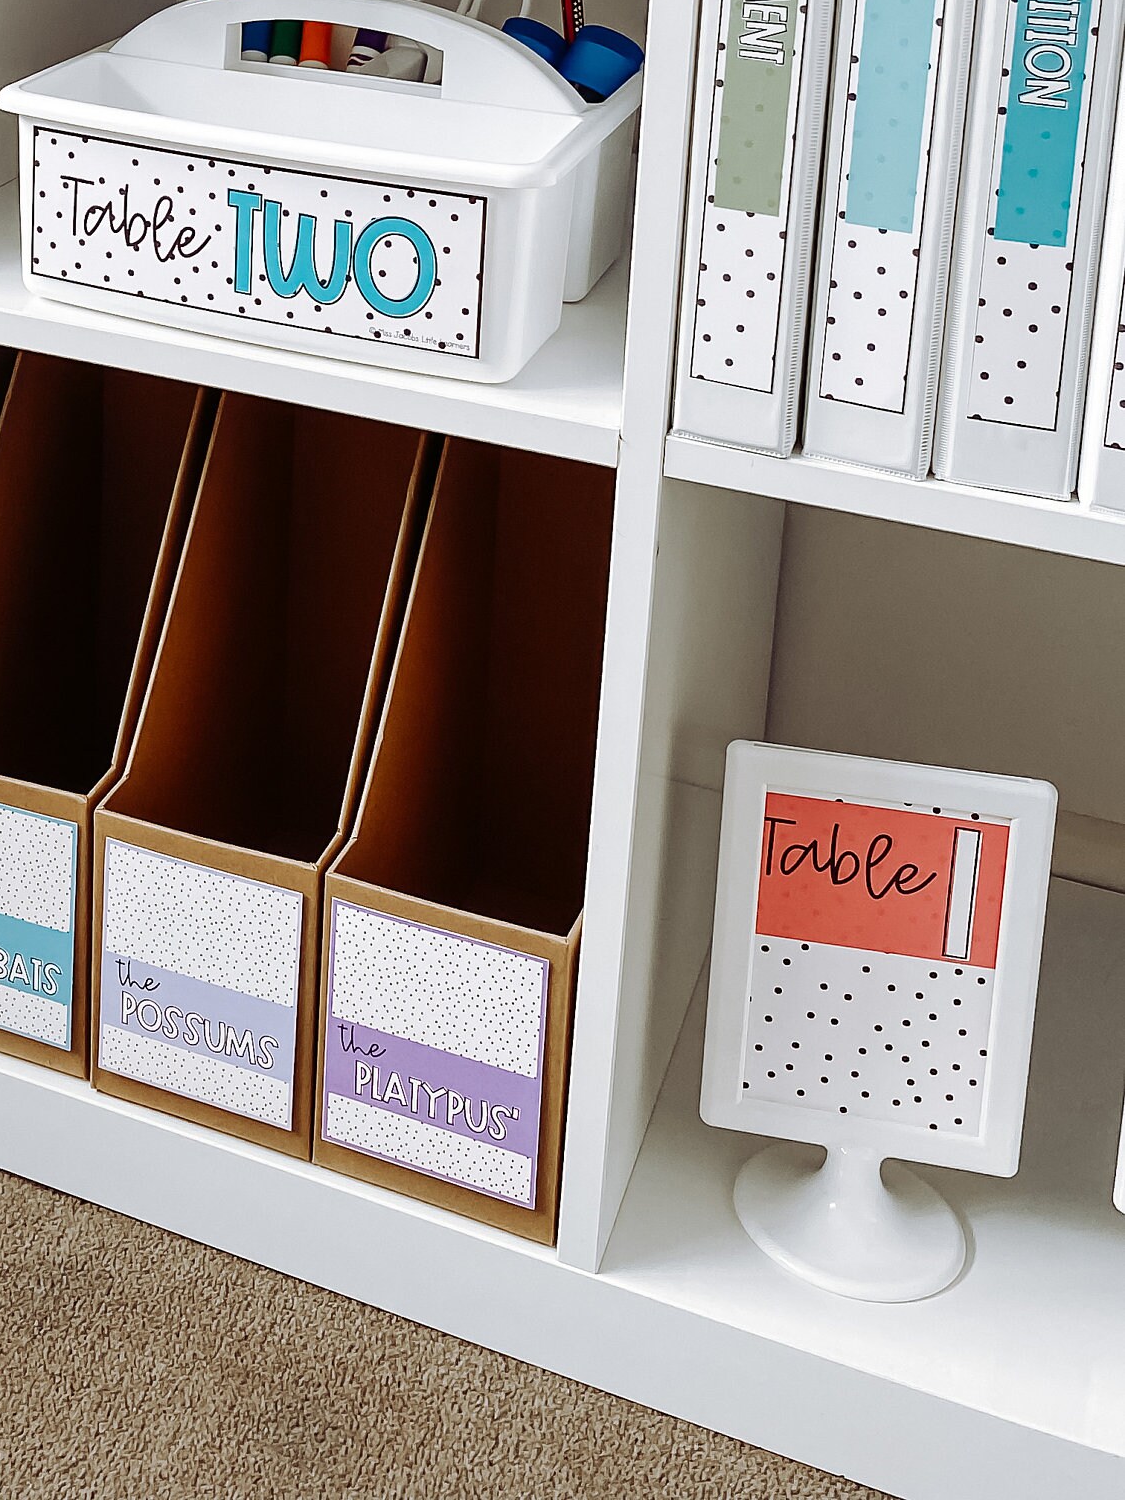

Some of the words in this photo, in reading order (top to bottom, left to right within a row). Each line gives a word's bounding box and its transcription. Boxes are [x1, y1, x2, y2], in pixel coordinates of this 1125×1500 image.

[60, 174, 212, 263] Table
[226, 187, 438, 319] TWO
[761, 816, 938, 900] Table
[941, 826, 984, 961] 1
[114, 958, 161, 992] the
[121, 990, 280, 1070] POSSUMS
[337, 1023, 387, 1058] the
